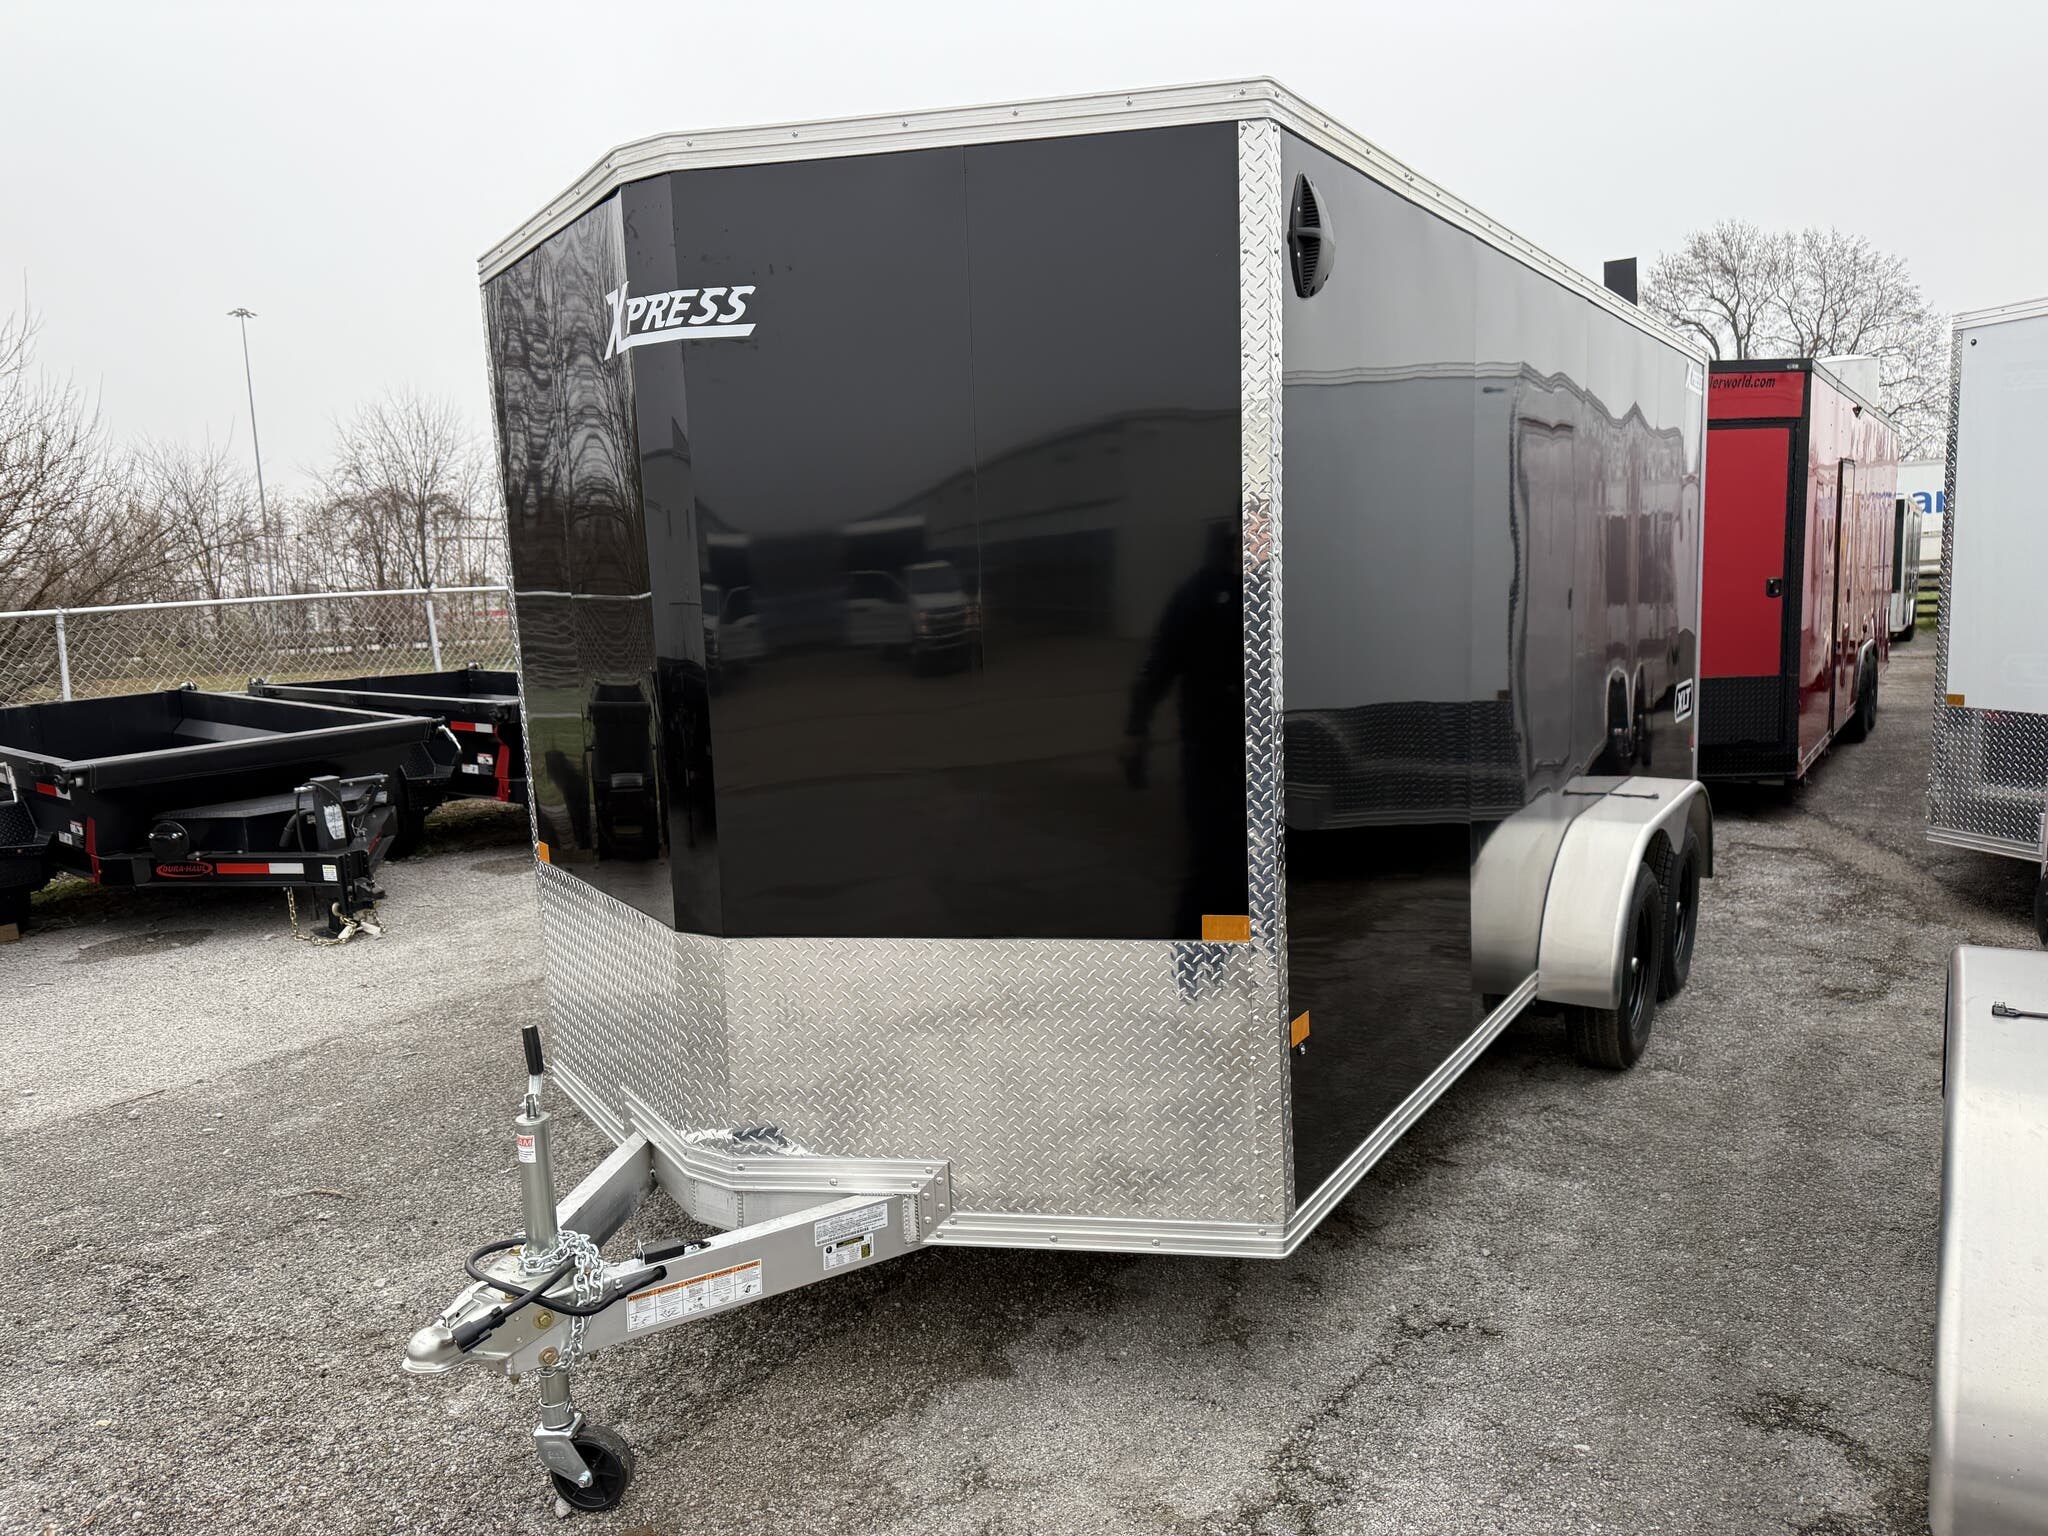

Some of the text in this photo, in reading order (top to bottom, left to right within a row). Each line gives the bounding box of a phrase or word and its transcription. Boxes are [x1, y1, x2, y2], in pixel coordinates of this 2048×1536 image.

[604, 281, 757, 360] XPRESS
[1709, 375, 1776, 388] lerworld.com
[1677, 687, 1690, 714] XLT
